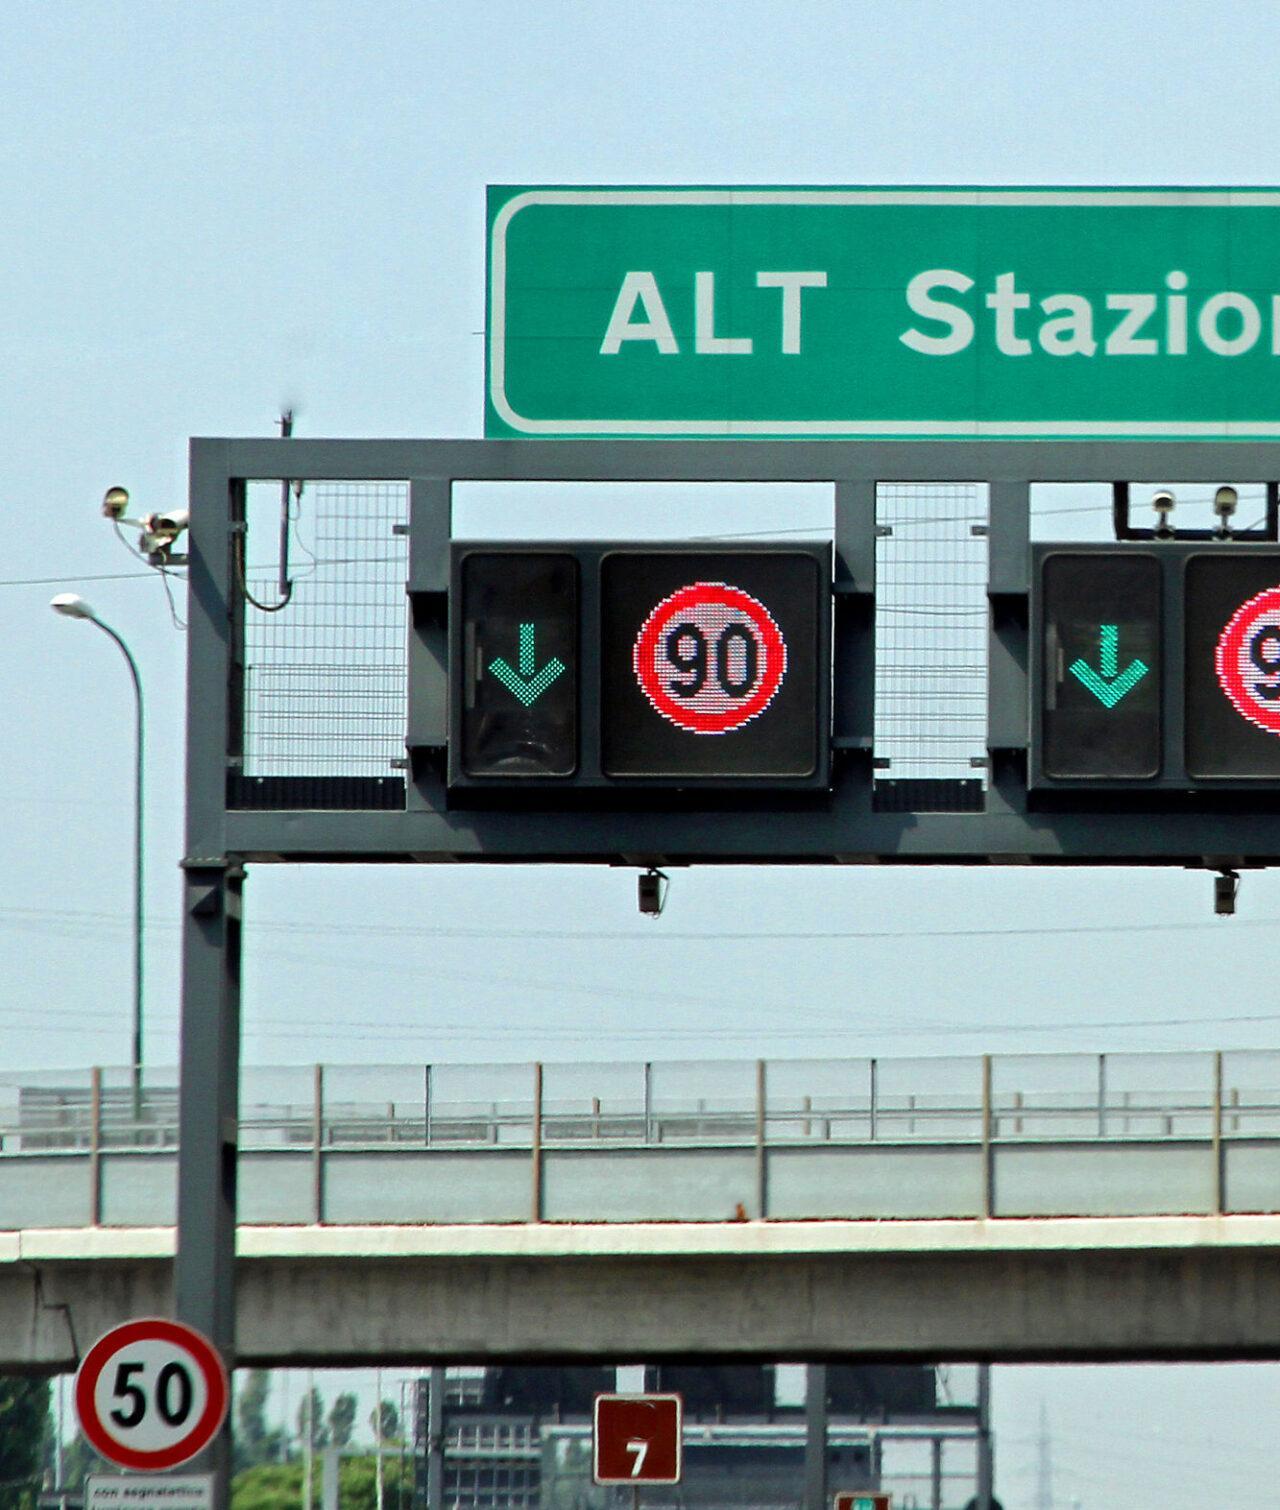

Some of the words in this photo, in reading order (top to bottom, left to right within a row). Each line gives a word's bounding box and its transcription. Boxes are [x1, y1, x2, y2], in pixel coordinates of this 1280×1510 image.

[599, 271, 827, 355] ALT
[666, 622, 758, 699] 90
[110, 1361, 193, 1428] 50
[626, 1441, 649, 1478] 7
